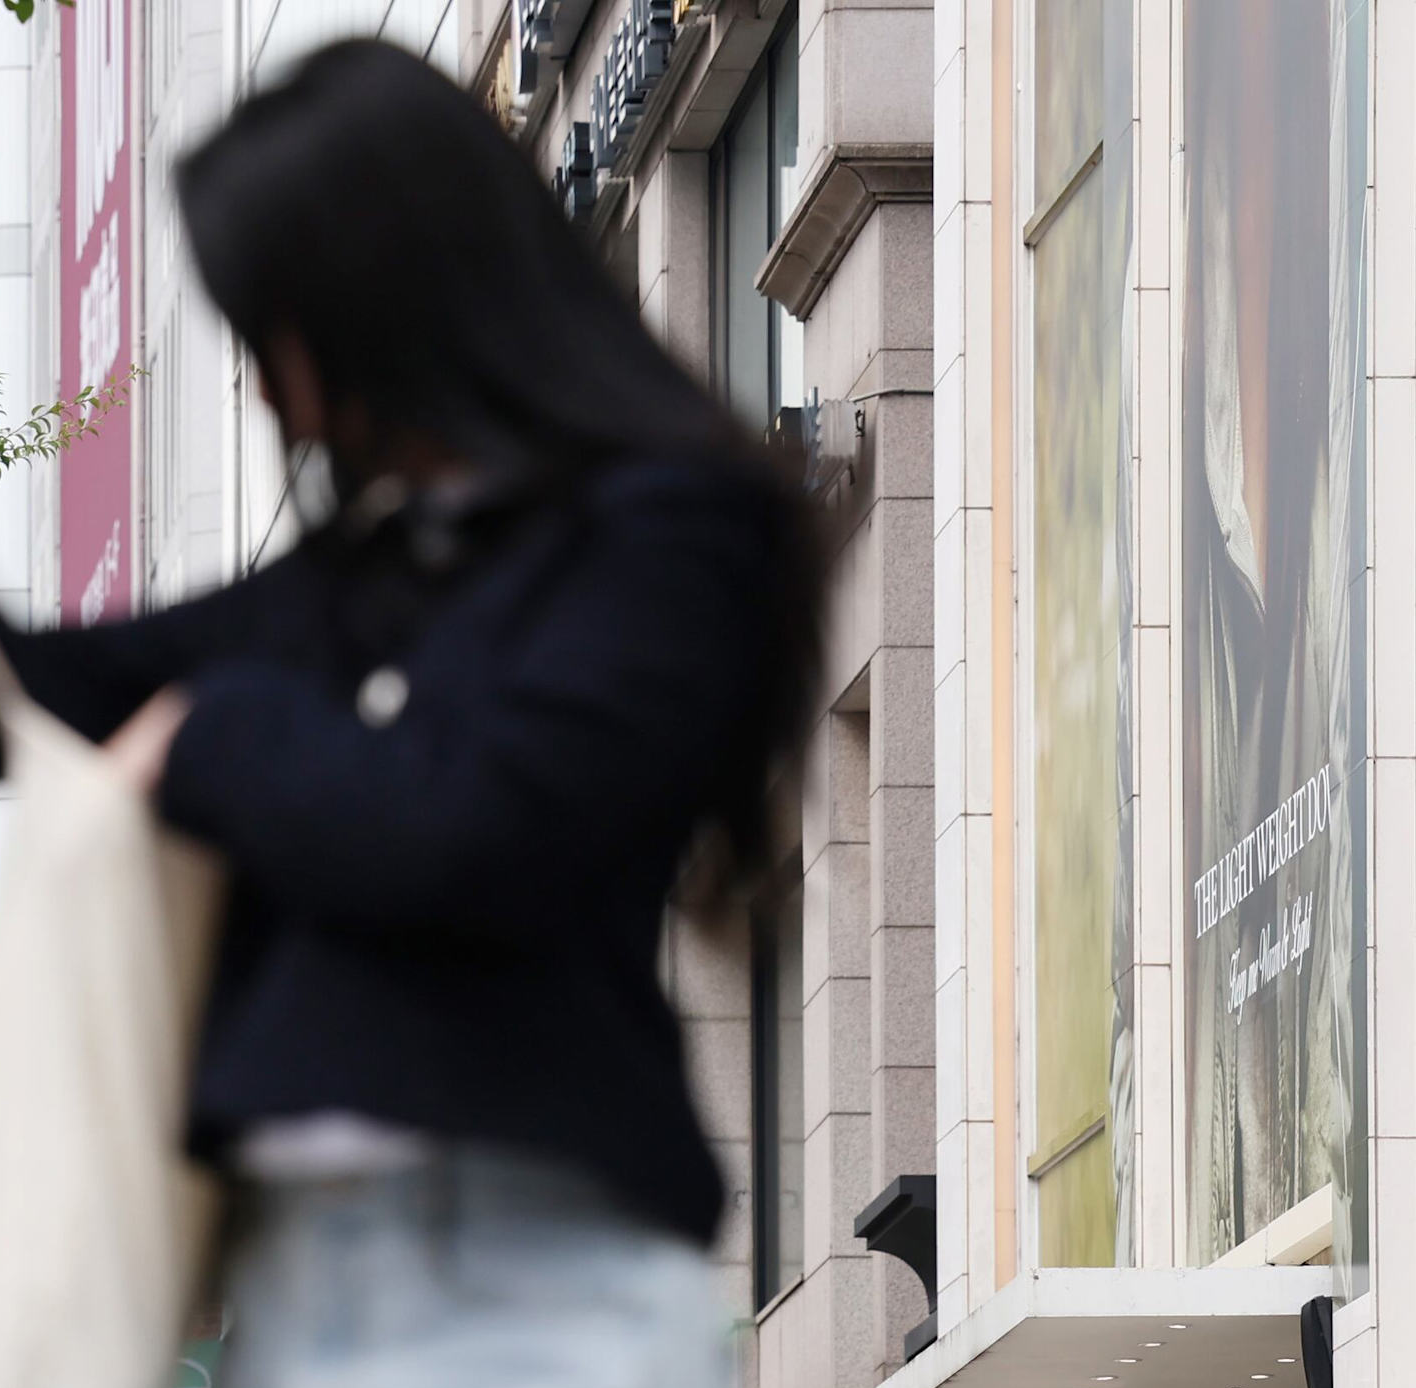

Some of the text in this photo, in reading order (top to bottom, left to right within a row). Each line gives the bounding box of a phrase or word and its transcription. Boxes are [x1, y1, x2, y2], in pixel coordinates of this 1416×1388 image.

[1194, 864, 1219, 939] THE
[1219, 830, 1256, 919] LIGHT
[1255, 786, 1307, 885] WEIGHT
